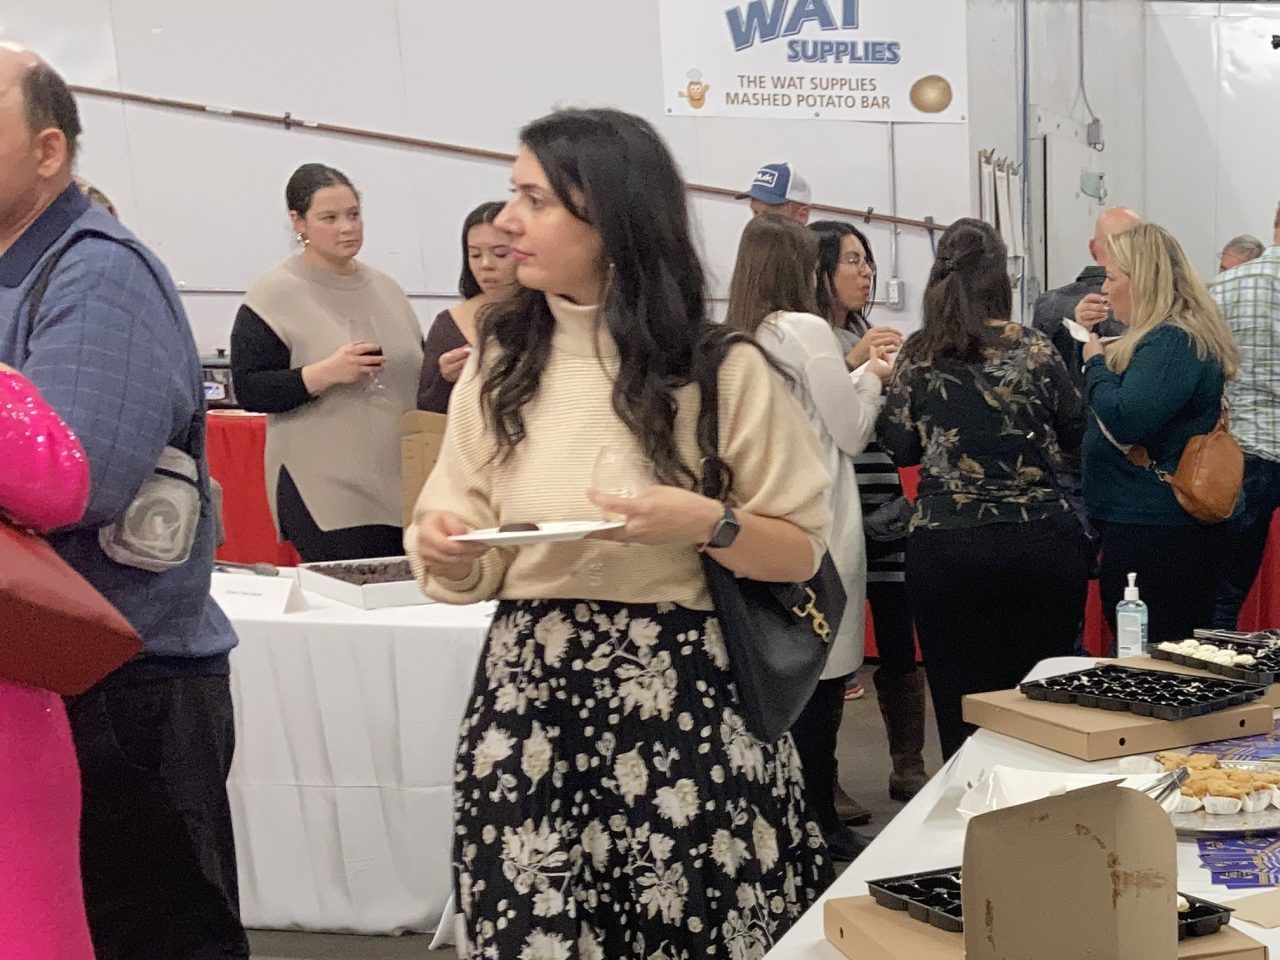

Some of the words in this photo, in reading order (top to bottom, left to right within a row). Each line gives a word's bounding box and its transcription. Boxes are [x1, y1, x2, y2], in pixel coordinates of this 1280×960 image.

[786, 39, 902, 65] SUPPLIES
[737, 74, 767, 90] THE
[771, 76, 805, 91] WAT
[810, 76, 877, 92] SUPPLIES
[725, 92, 792, 107] MASHED
[796, 94, 857, 109] POTATO
[861, 95, 892, 110] BAR
